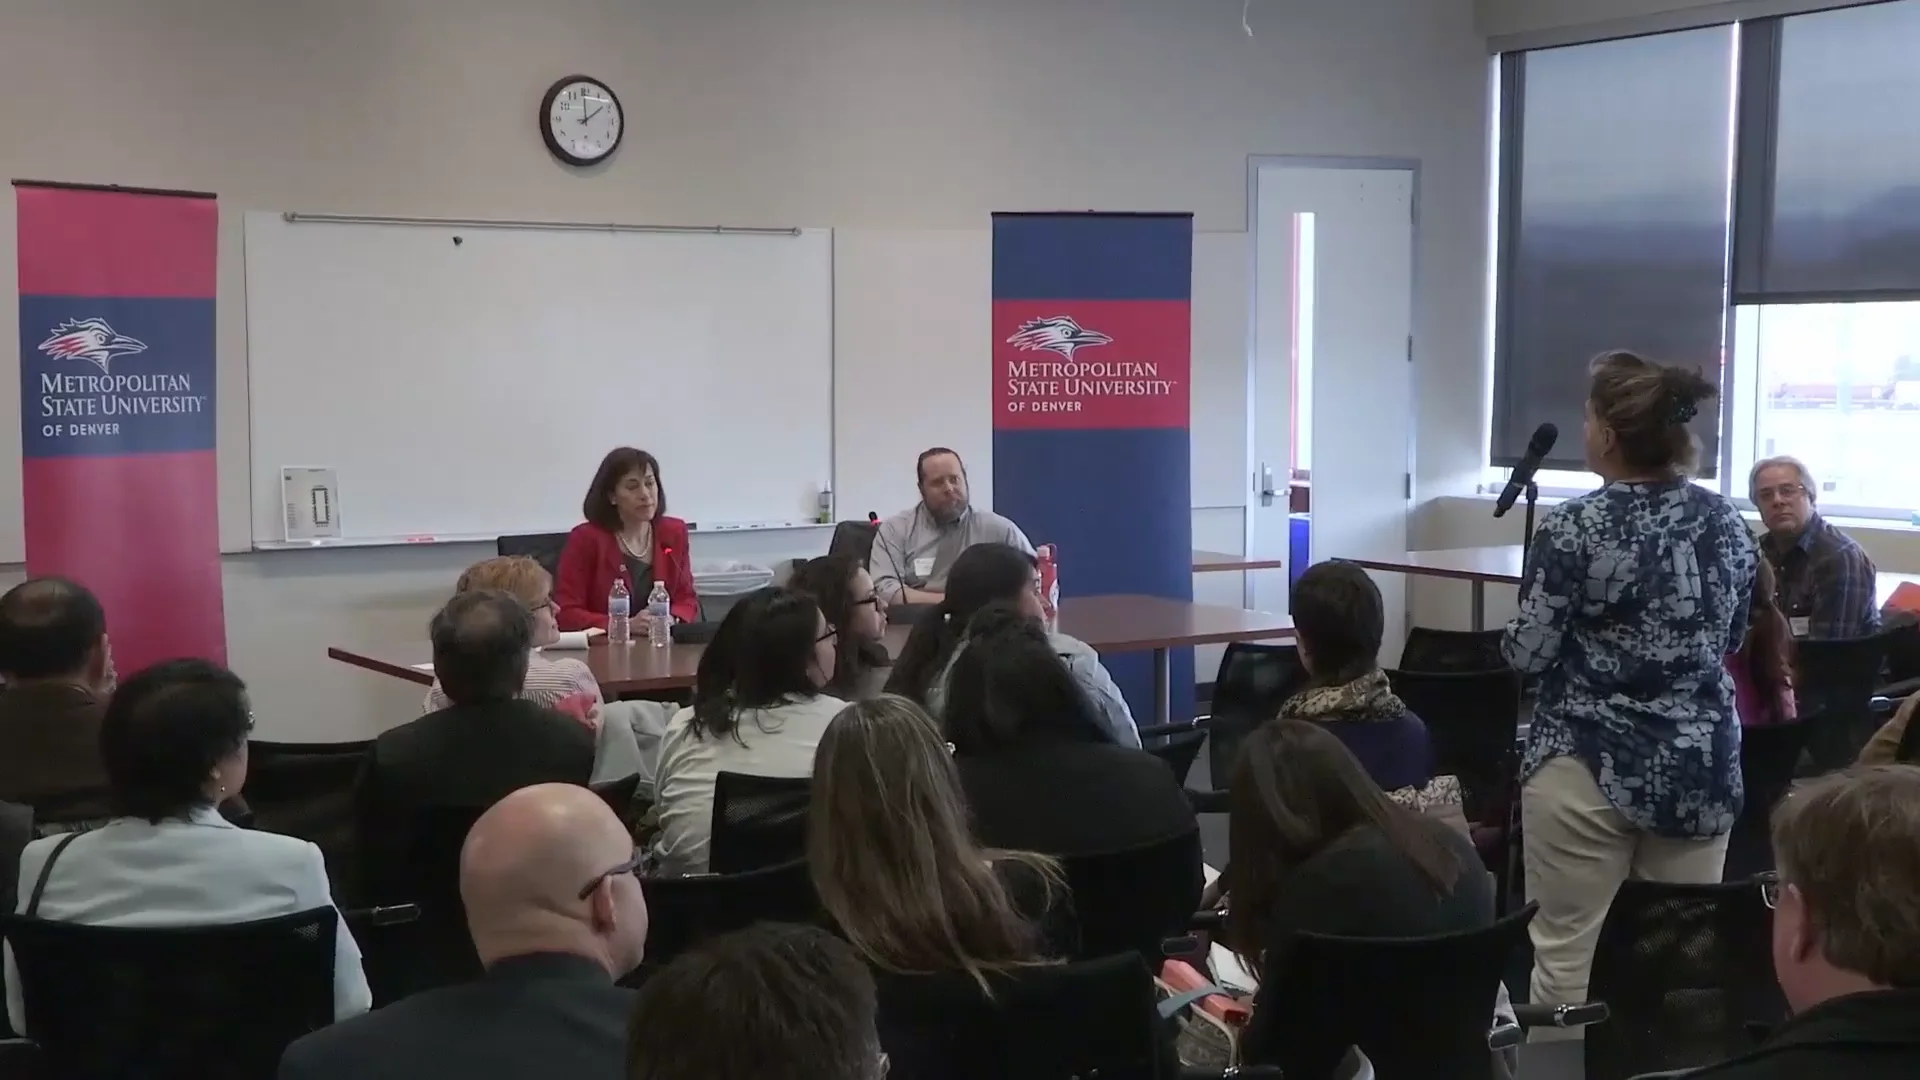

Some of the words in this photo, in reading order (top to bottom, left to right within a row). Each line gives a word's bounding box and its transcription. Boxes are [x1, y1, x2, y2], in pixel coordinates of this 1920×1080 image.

[1008, 361, 1158, 378] METROPOLITAN
[41, 373, 191, 393] METROPOLITAN
[1008, 379, 1059, 396] STATE
[1064, 379, 1173, 395] UNIVERSITY
[41, 396, 97, 417] STATE
[101, 395, 203, 415] UNIVERSITY
[1008, 402, 1025, 412] OF
[1032, 401, 1082, 412] DENVER
[43, 425, 62, 437] OF
[70, 423, 120, 436] DENVER
